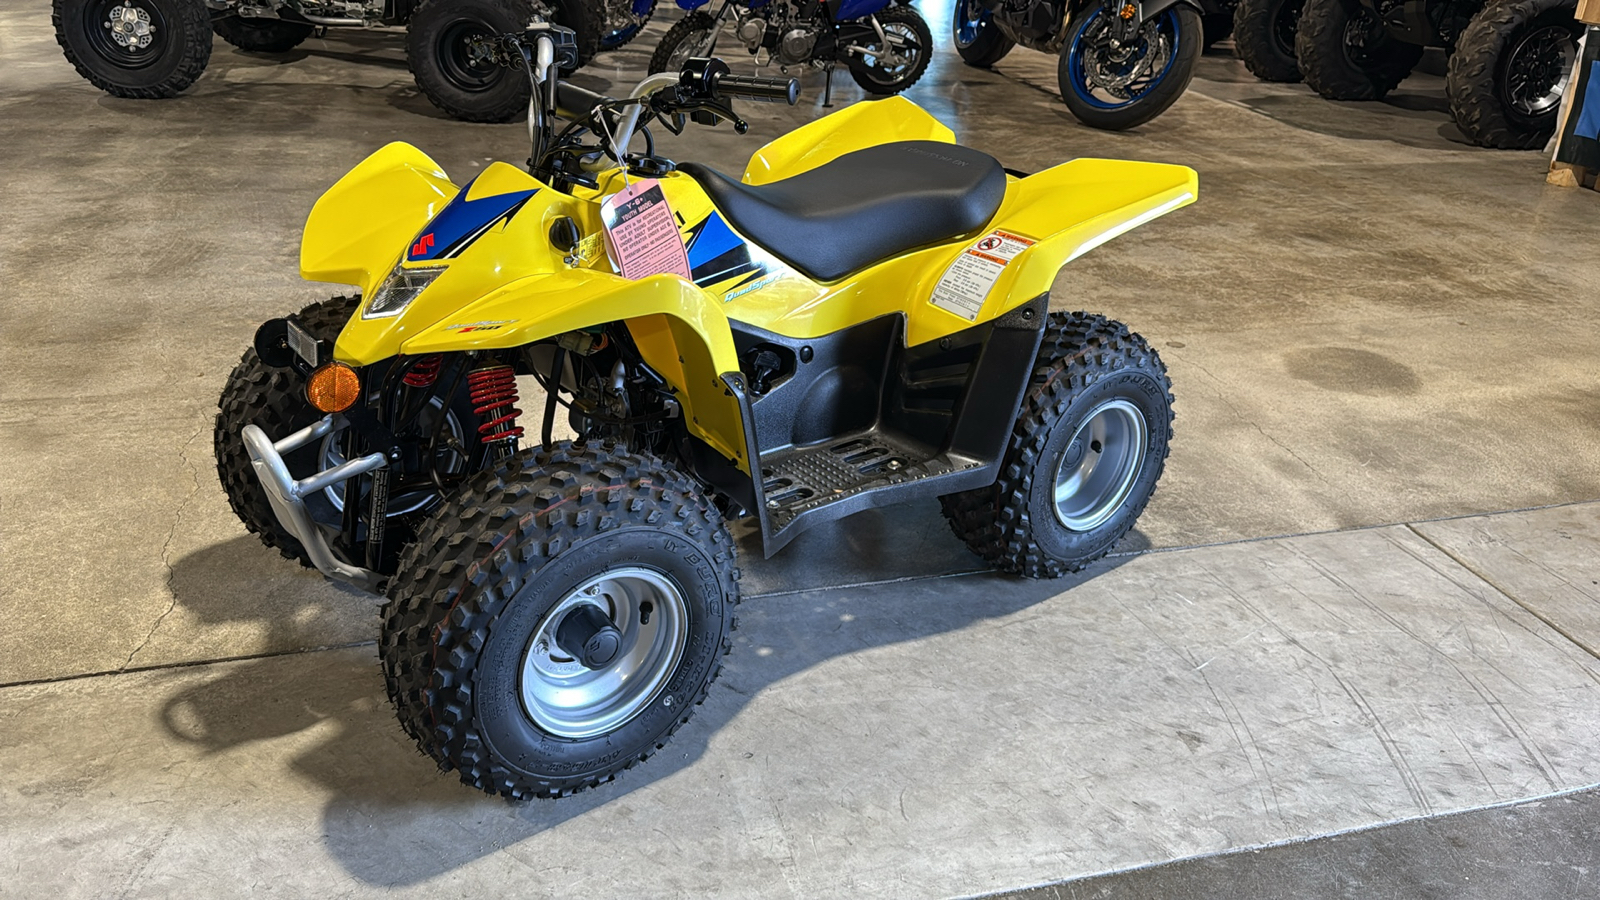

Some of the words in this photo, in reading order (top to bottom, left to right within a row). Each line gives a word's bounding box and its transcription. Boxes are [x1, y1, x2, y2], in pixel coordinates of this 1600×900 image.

[622, 209, 638, 221] YOUTH
[638, 201, 653, 212] MODEL
[634, 223, 646, 232] YOUNG
[647, 211, 666, 225] OPERATORS
[642, 205, 665, 220] RECREATIONAL
[619, 238, 633, 248] UNDER
[634, 230, 646, 239] ADULT
[625, 248, 641, 260] OPERATOR
[655, 229, 673, 242] PASSENGERS
[629, 236, 647, 249] OPERATOR
[648, 229, 660, 238] UNDER
[724, 272, 787, 303] QuadSport
[1119, 375, 1160, 397] DURO
[684, 552, 720, 616] DURO
